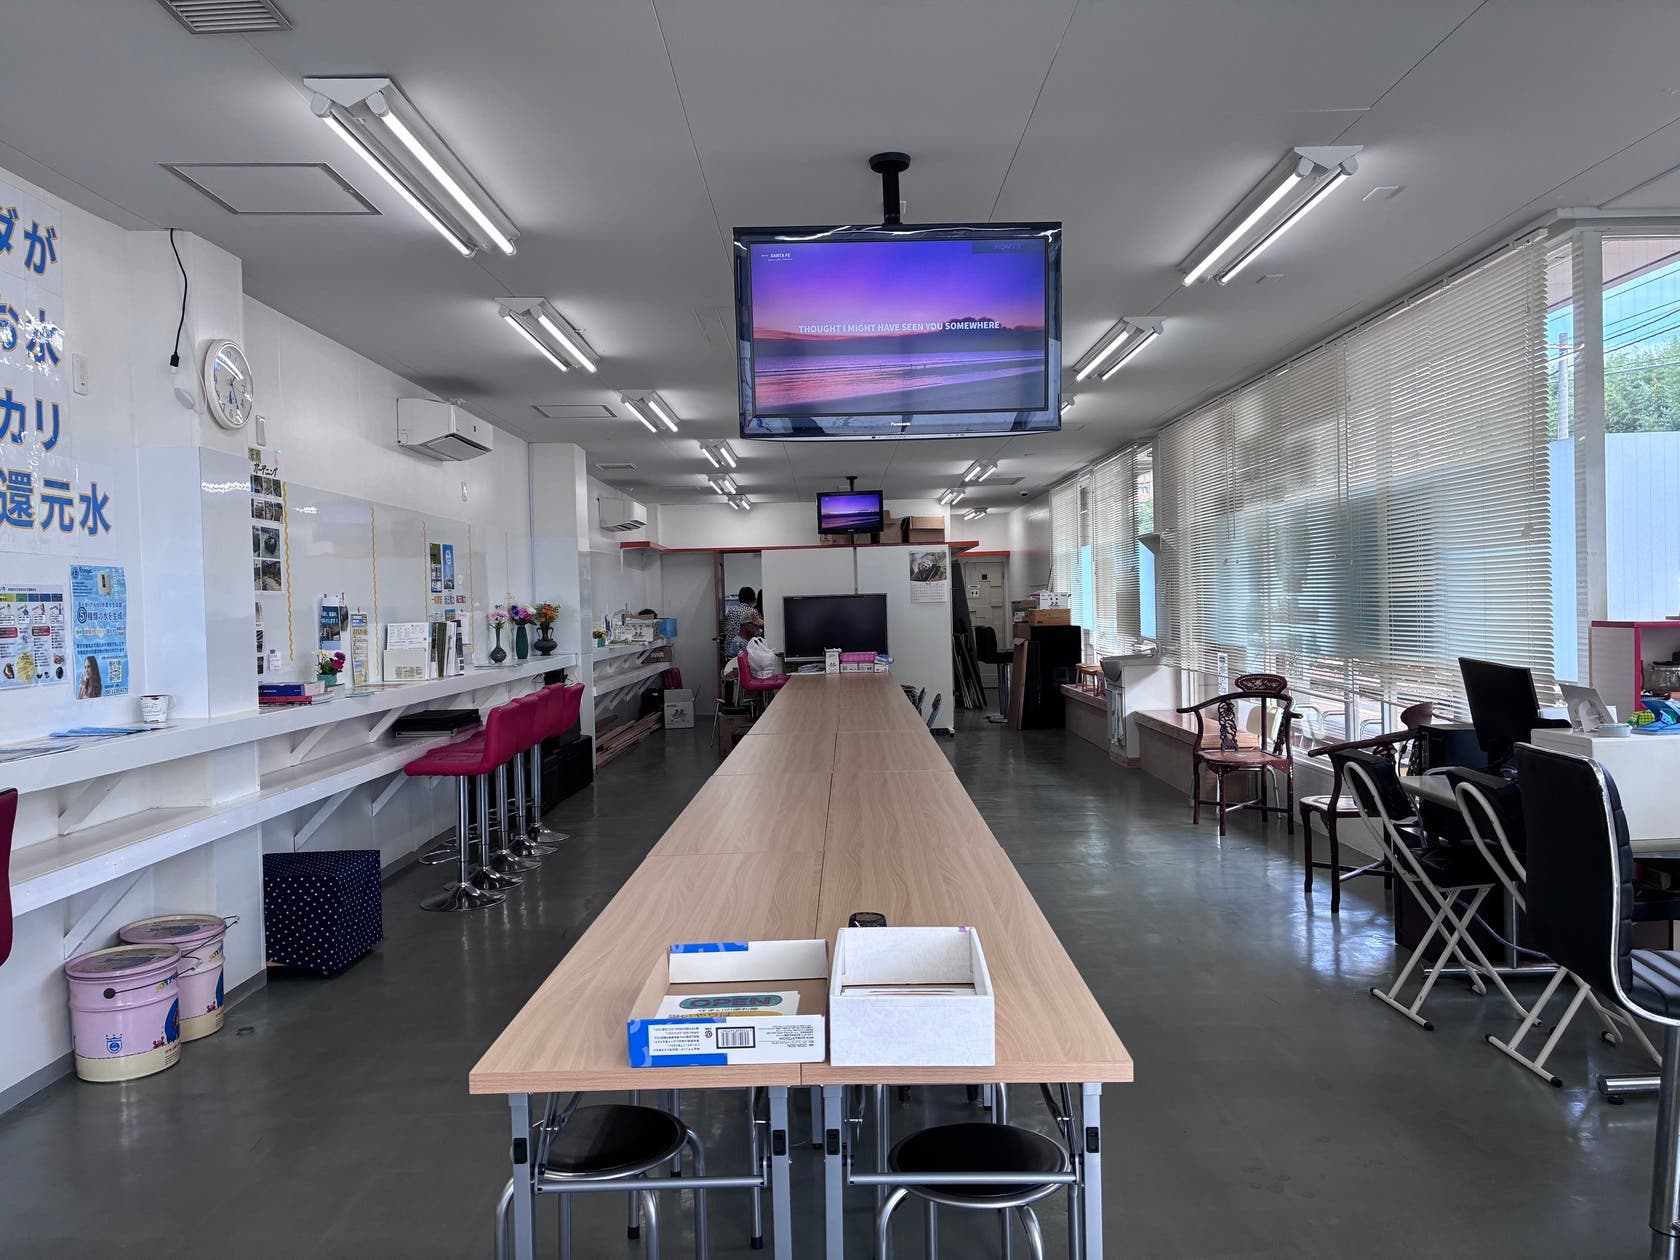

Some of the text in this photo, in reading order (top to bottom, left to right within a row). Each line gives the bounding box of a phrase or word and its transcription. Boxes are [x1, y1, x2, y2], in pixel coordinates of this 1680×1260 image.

[799, 325, 841, 333] THOUGHT
[847, 324, 876, 332] MIGHT
[877, 323, 900, 332] HAVE
[902, 323, 924, 331] SEEN
[925, 322, 943, 330] YOU
[945, 321, 1000, 330] SOMEWHERE
[0, 469, 111, 535] 還元水
[689, 995, 773, 1008] OPEN
